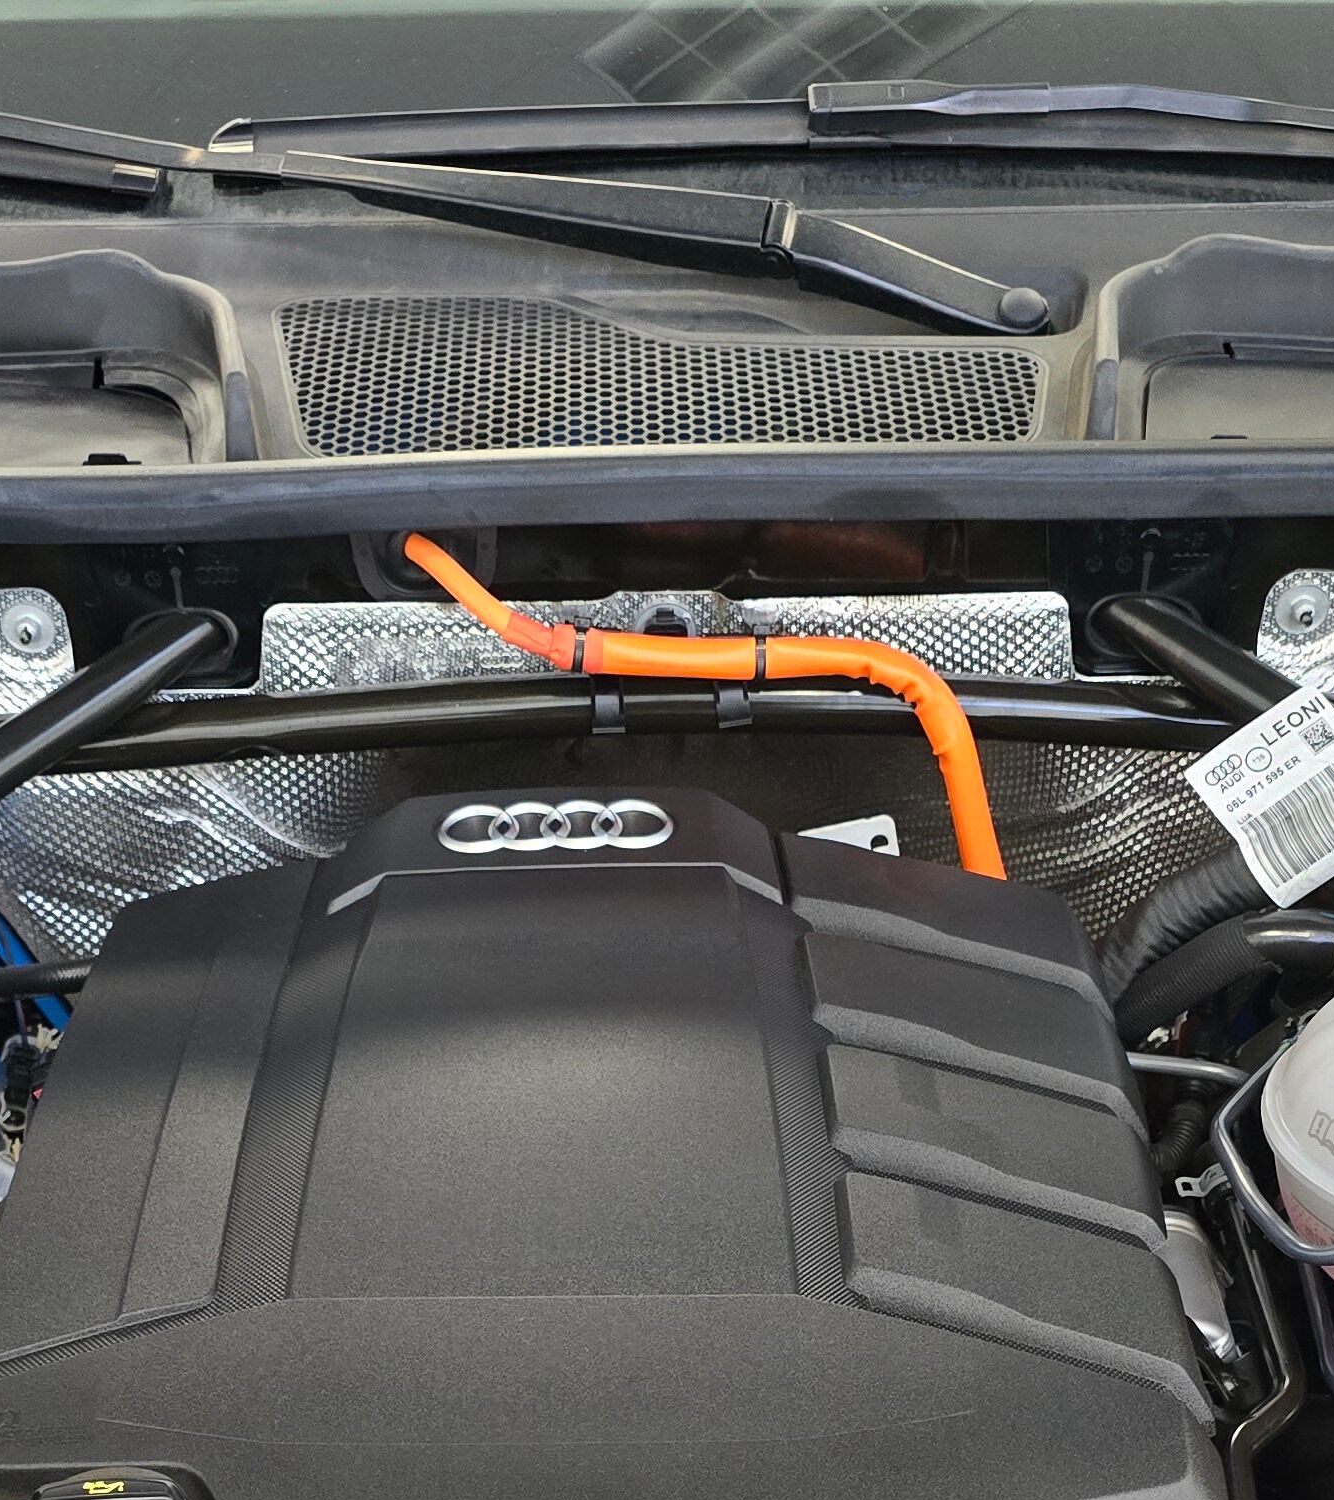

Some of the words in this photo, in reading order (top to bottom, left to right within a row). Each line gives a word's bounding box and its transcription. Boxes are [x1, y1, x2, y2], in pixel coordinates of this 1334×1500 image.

[1260, 697, 1325, 746] LEONI
[1220, 770, 1245, 794] AUDI
[1245, 781, 1265, 798] 971
[1284, 755, 1301, 770] ER
